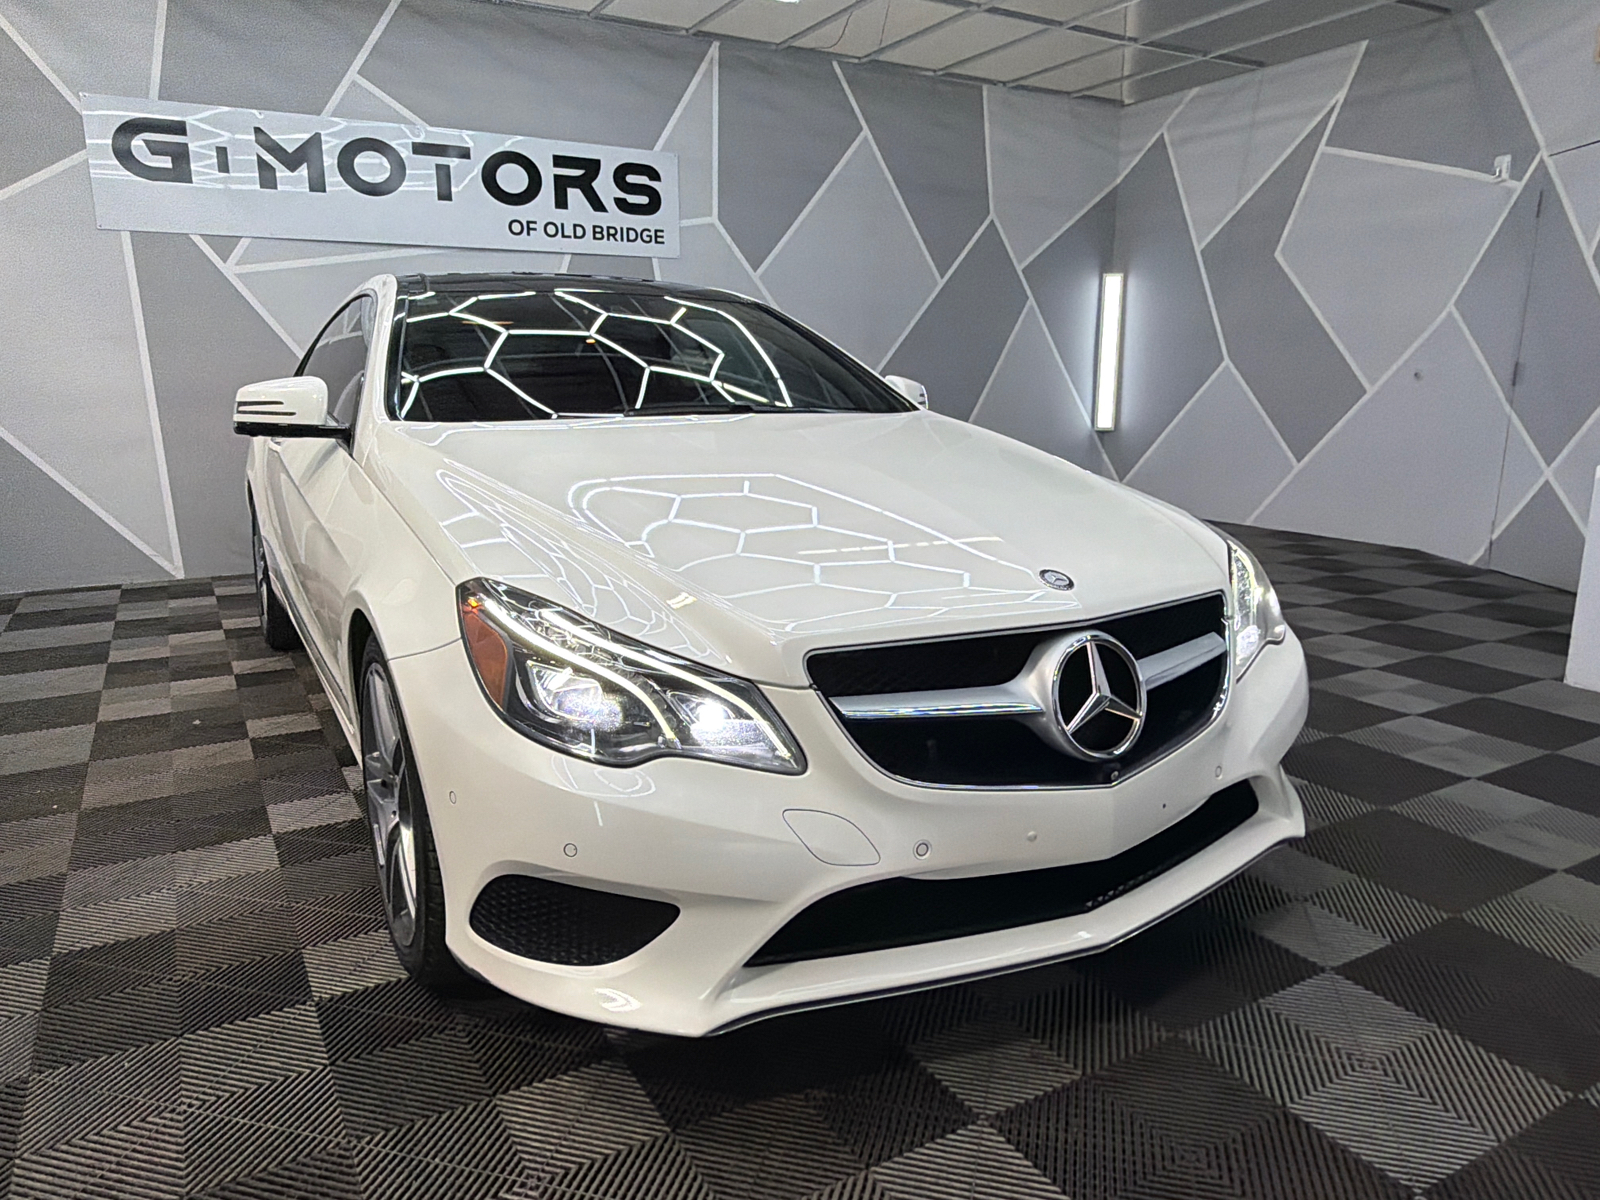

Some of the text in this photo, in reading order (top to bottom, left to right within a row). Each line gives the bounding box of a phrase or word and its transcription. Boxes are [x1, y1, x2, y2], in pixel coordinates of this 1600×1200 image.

[508, 219, 665, 245] OF OLD BRIDGE
